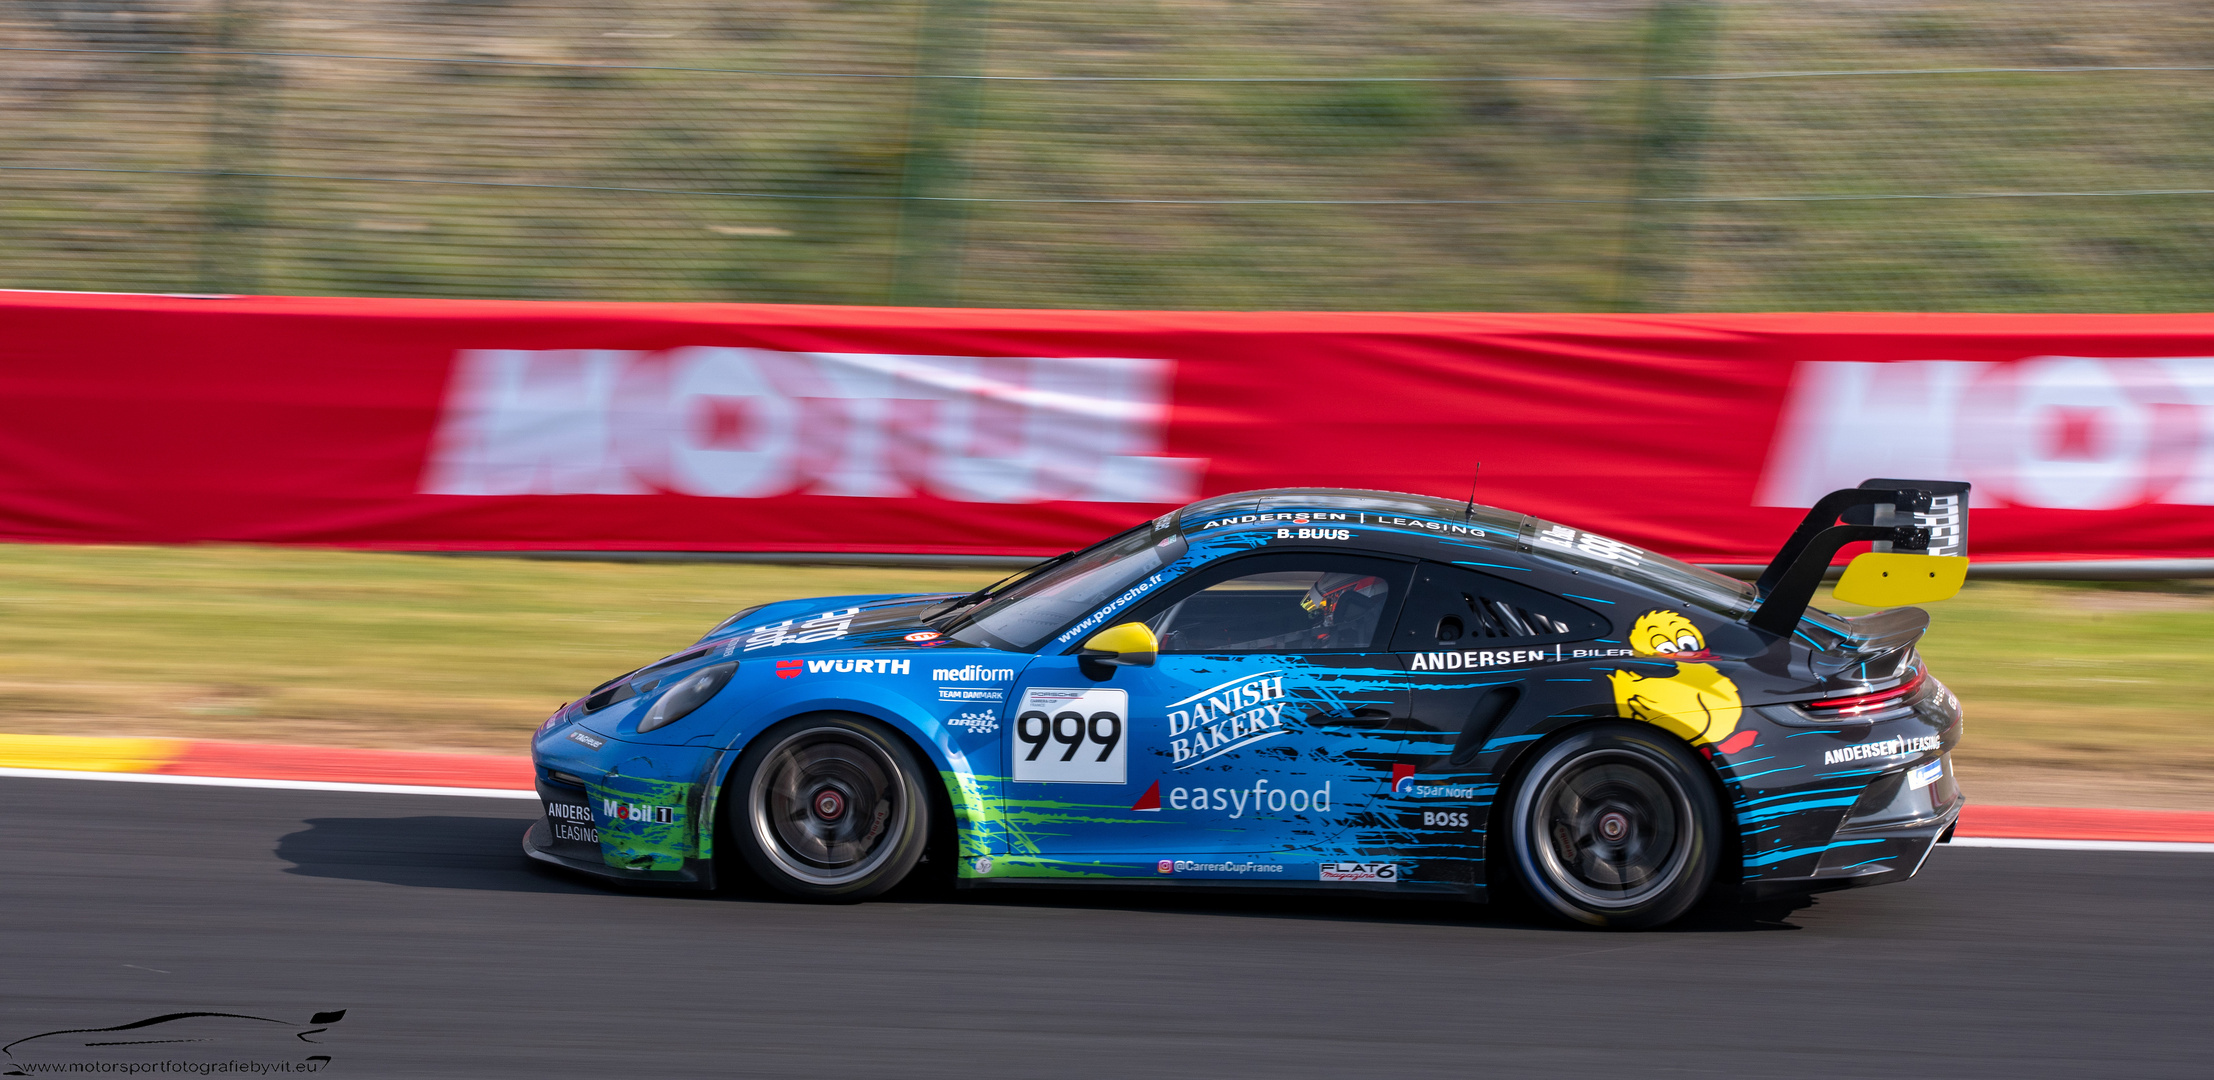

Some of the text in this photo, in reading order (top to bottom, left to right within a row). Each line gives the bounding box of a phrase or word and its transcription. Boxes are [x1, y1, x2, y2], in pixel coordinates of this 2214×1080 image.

[1203, 512, 1486, 537] ANDERSEN LEASING
[1277, 528, 1350, 541] B. BUUS
[1058, 573, 1163, 644] www.porsche.fr
[807, 659, 911, 675] WÜRTH
[1411, 648, 1634, 671] ANDERSEN BILER
[932, 665, 1014, 682] mediform
[938, 690, 1003, 699] TEAM DANMARK
[1166, 676, 1286, 737] DANISH
[1017, 710, 1122, 762] 999
[1170, 702, 1287, 764] BAKERY
[1824, 734, 1941, 765] ANDERSEN LEASING
[1169, 779, 1331, 819] easyfood
[603, 799, 653, 823] Mobil
[1423, 811, 1470, 827] BOSS
[555, 824, 599, 843] LEASING
[1174, 860, 1284, 874] @CarreraCupFrance
[1320, 863, 1395, 879] FLAT 6
